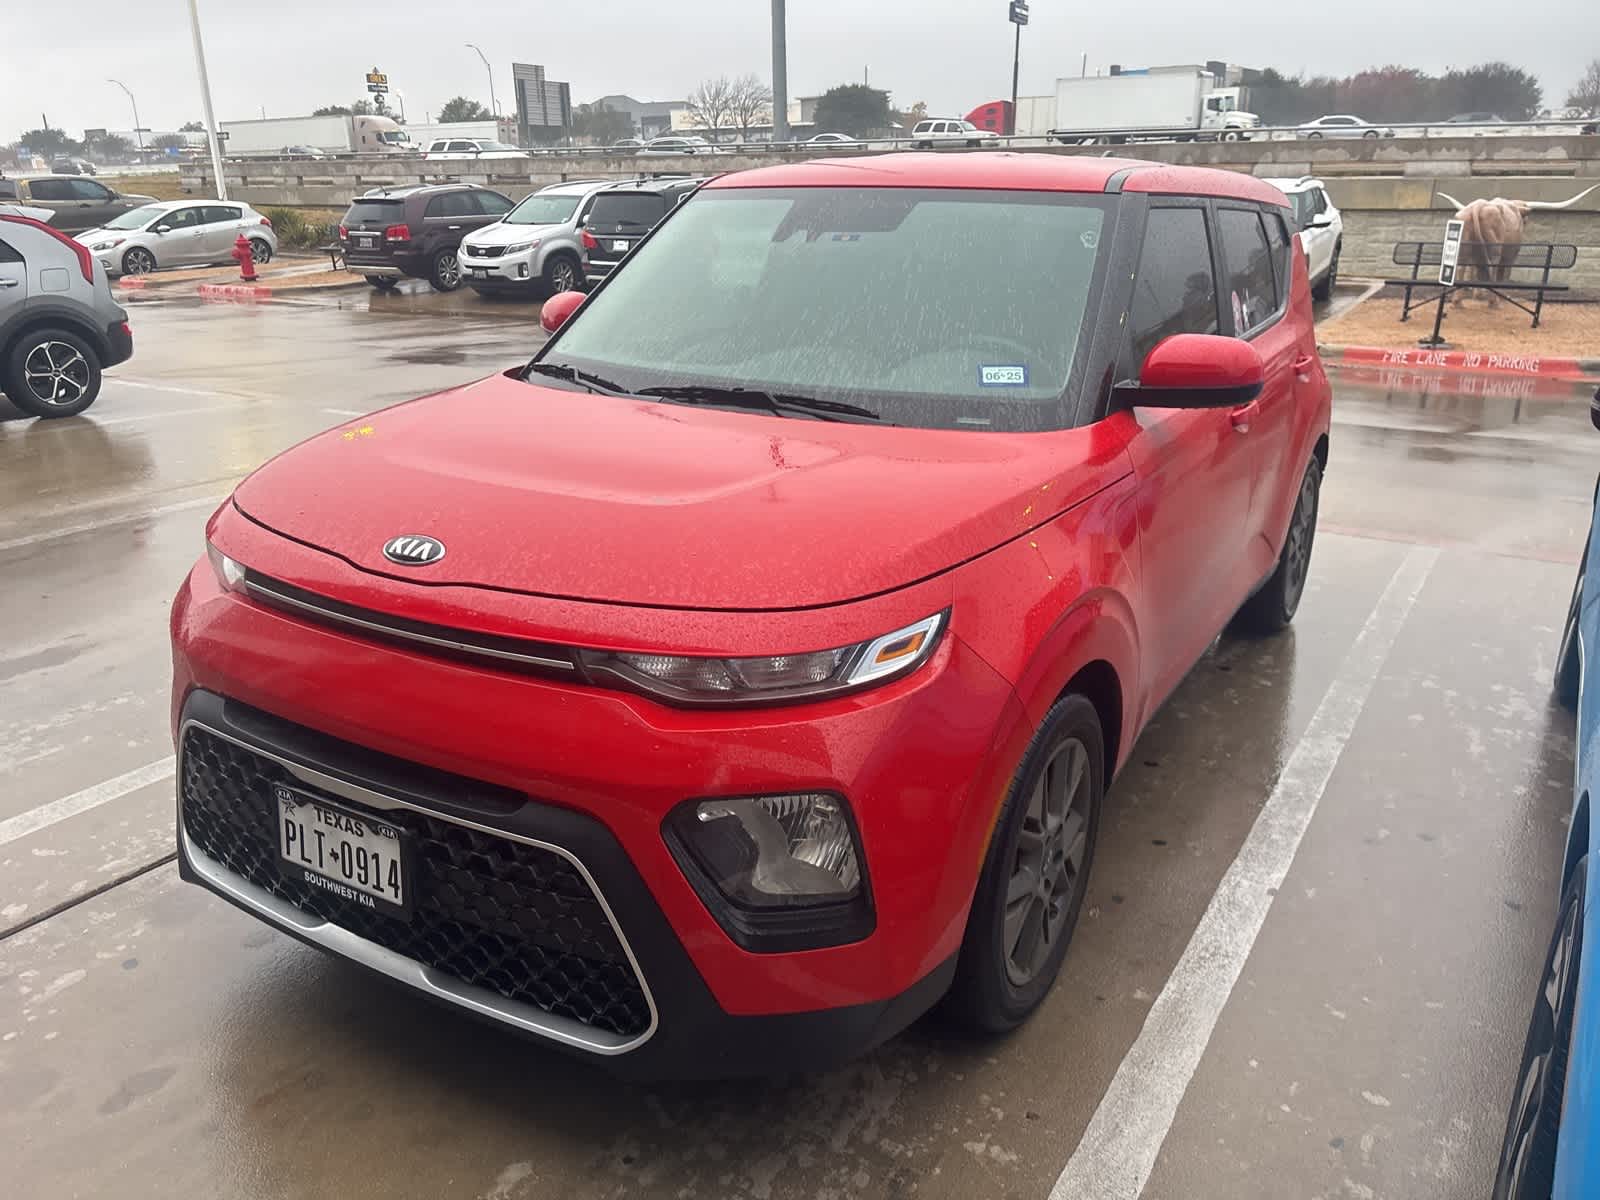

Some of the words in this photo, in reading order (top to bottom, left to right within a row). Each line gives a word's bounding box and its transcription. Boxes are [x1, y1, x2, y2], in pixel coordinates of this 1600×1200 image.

[1382, 350, 1409, 364] FIRE
[1416, 351, 1447, 367] LANE
[1463, 352, 1481, 368] NO
[1487, 356, 1540, 373] PARKING
[388, 537, 433, 561] KIA
[312, 806, 365, 838] TEXAS
[304, 871, 358, 902] SOUTHWEST
[359, 893, 375, 908] KIA
